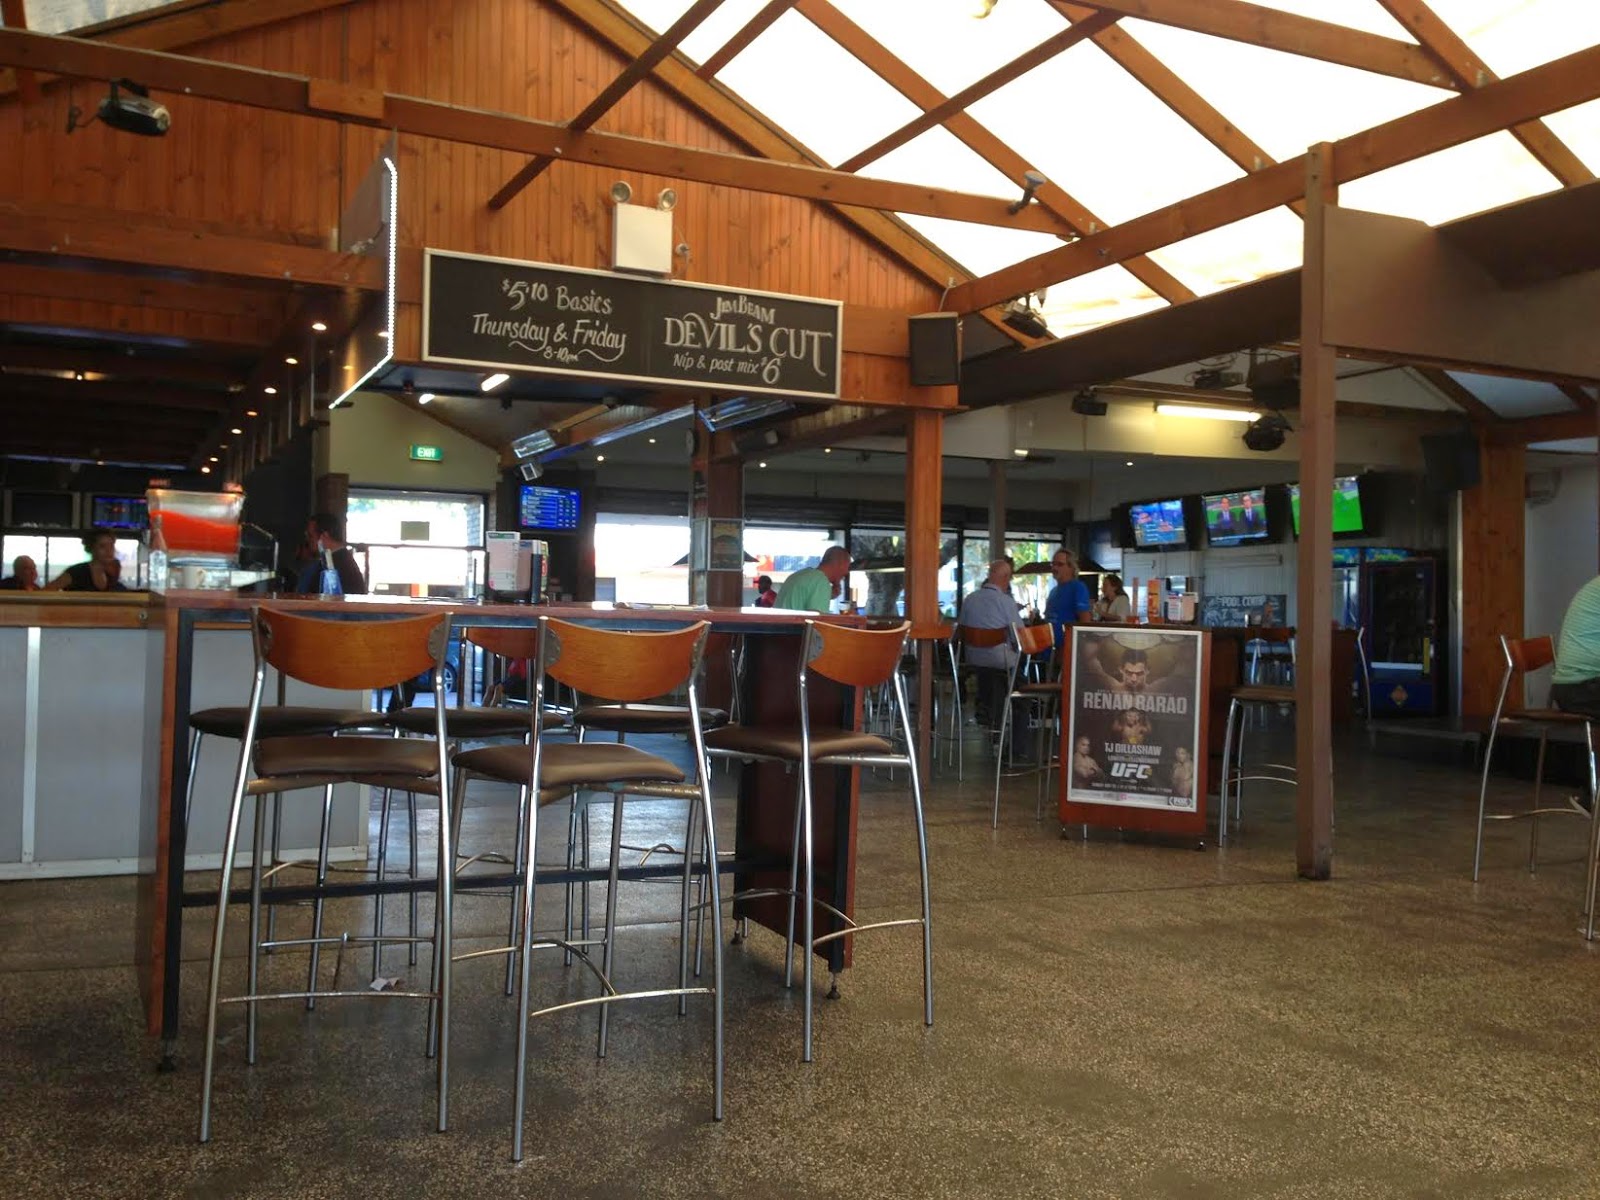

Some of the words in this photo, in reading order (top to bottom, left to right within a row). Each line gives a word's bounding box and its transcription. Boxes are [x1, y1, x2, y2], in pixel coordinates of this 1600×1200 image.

[556, 285, 613, 315] Basics
[738, 295, 775, 325] BEAM
[473, 313, 550, 352] Thursday
[553, 322, 568, 342] &
[573, 319, 627, 362] Friday
[664, 312, 763, 354] DEVIL'S
[769, 326, 833, 377] CUT
[673, 352, 694, 371] Nip
[695, 354, 706, 369] &
[737, 360, 760, 375] mix
[417, 447, 436, 458] EXIT
[1083, 691, 1133, 711] RENAN
[1104, 742, 1114, 753] TJ
[1115, 744, 1162, 756] DILLASHAW
[1111, 762, 1150, 779] UFC
